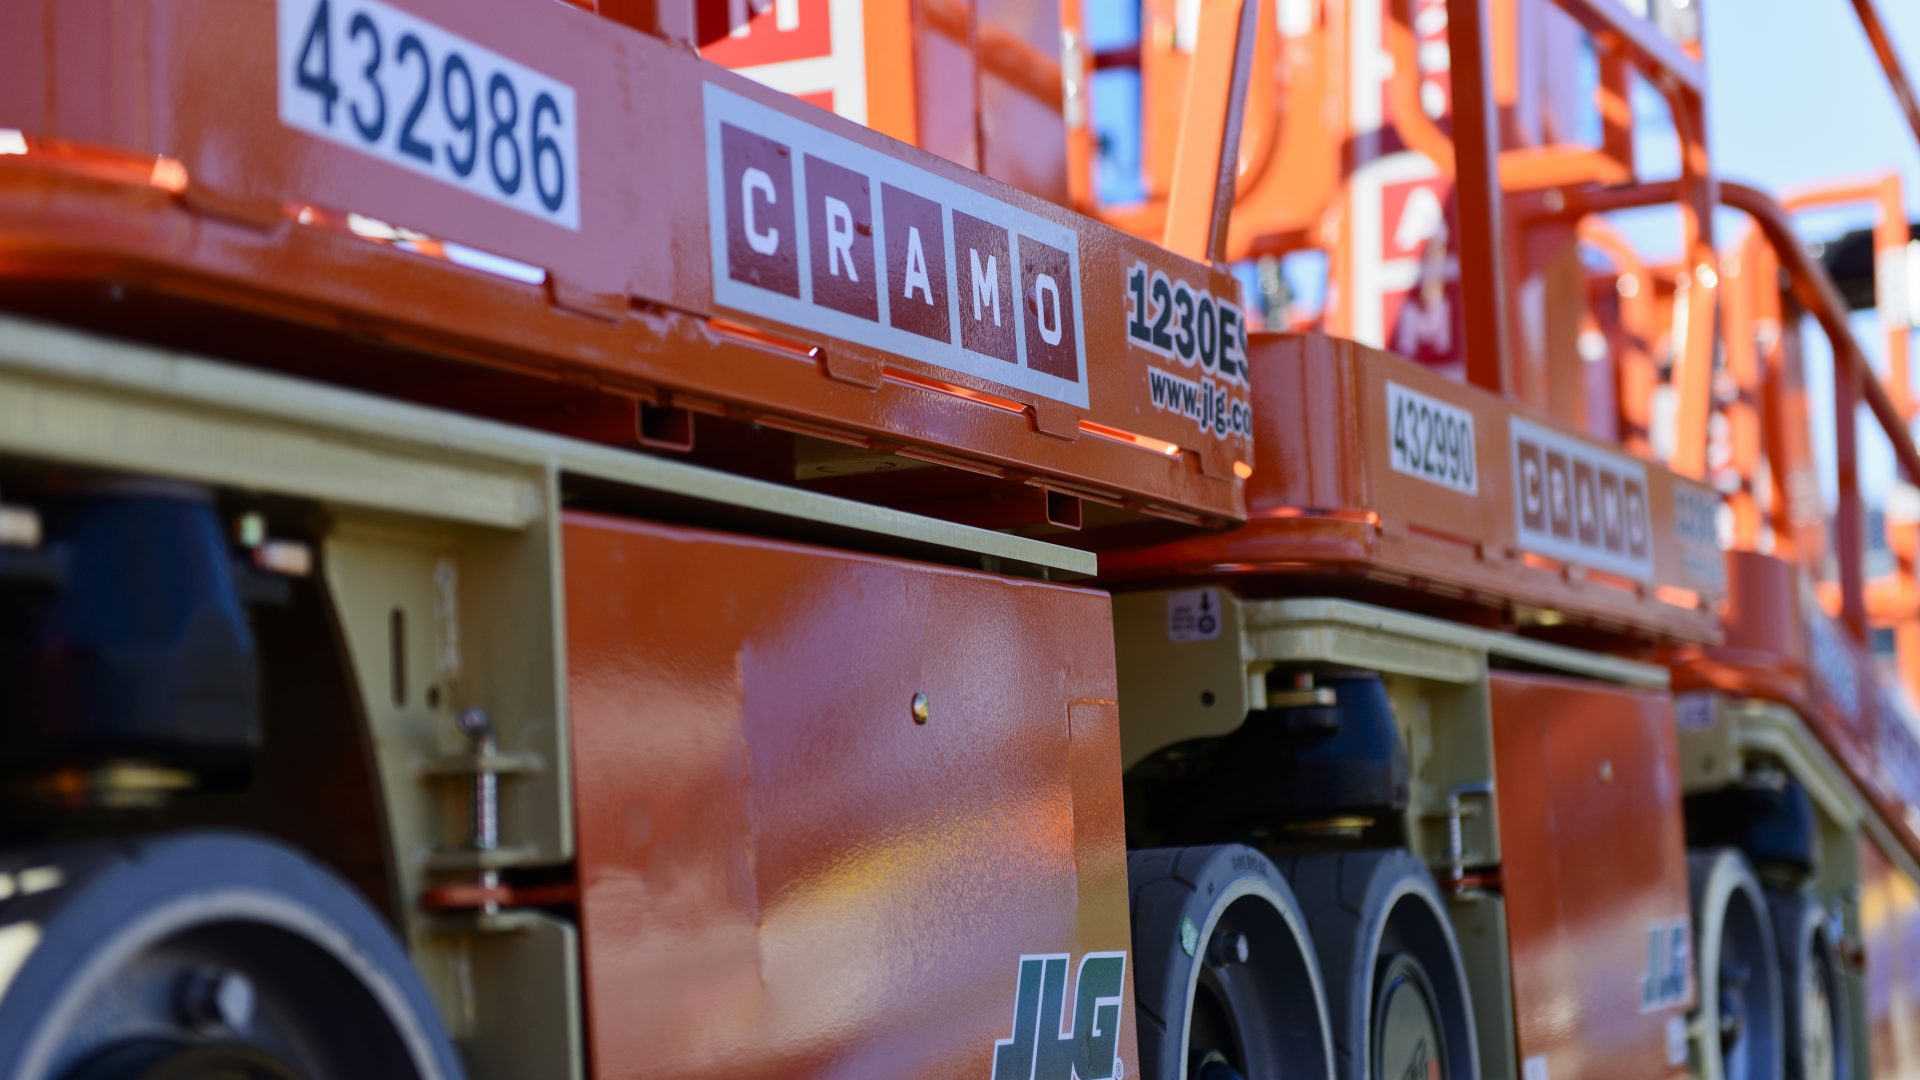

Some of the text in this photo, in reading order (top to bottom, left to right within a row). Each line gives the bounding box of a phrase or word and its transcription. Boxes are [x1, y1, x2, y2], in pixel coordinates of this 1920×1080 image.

[295, 0, 565, 213] 432986
[741, 166, 1063, 347] CRAMO
[1393, 394, 1474, 488] 432990
[1521, 457, 1648, 546] CRAMO
[991, 951, 1127, 1080] JLG
